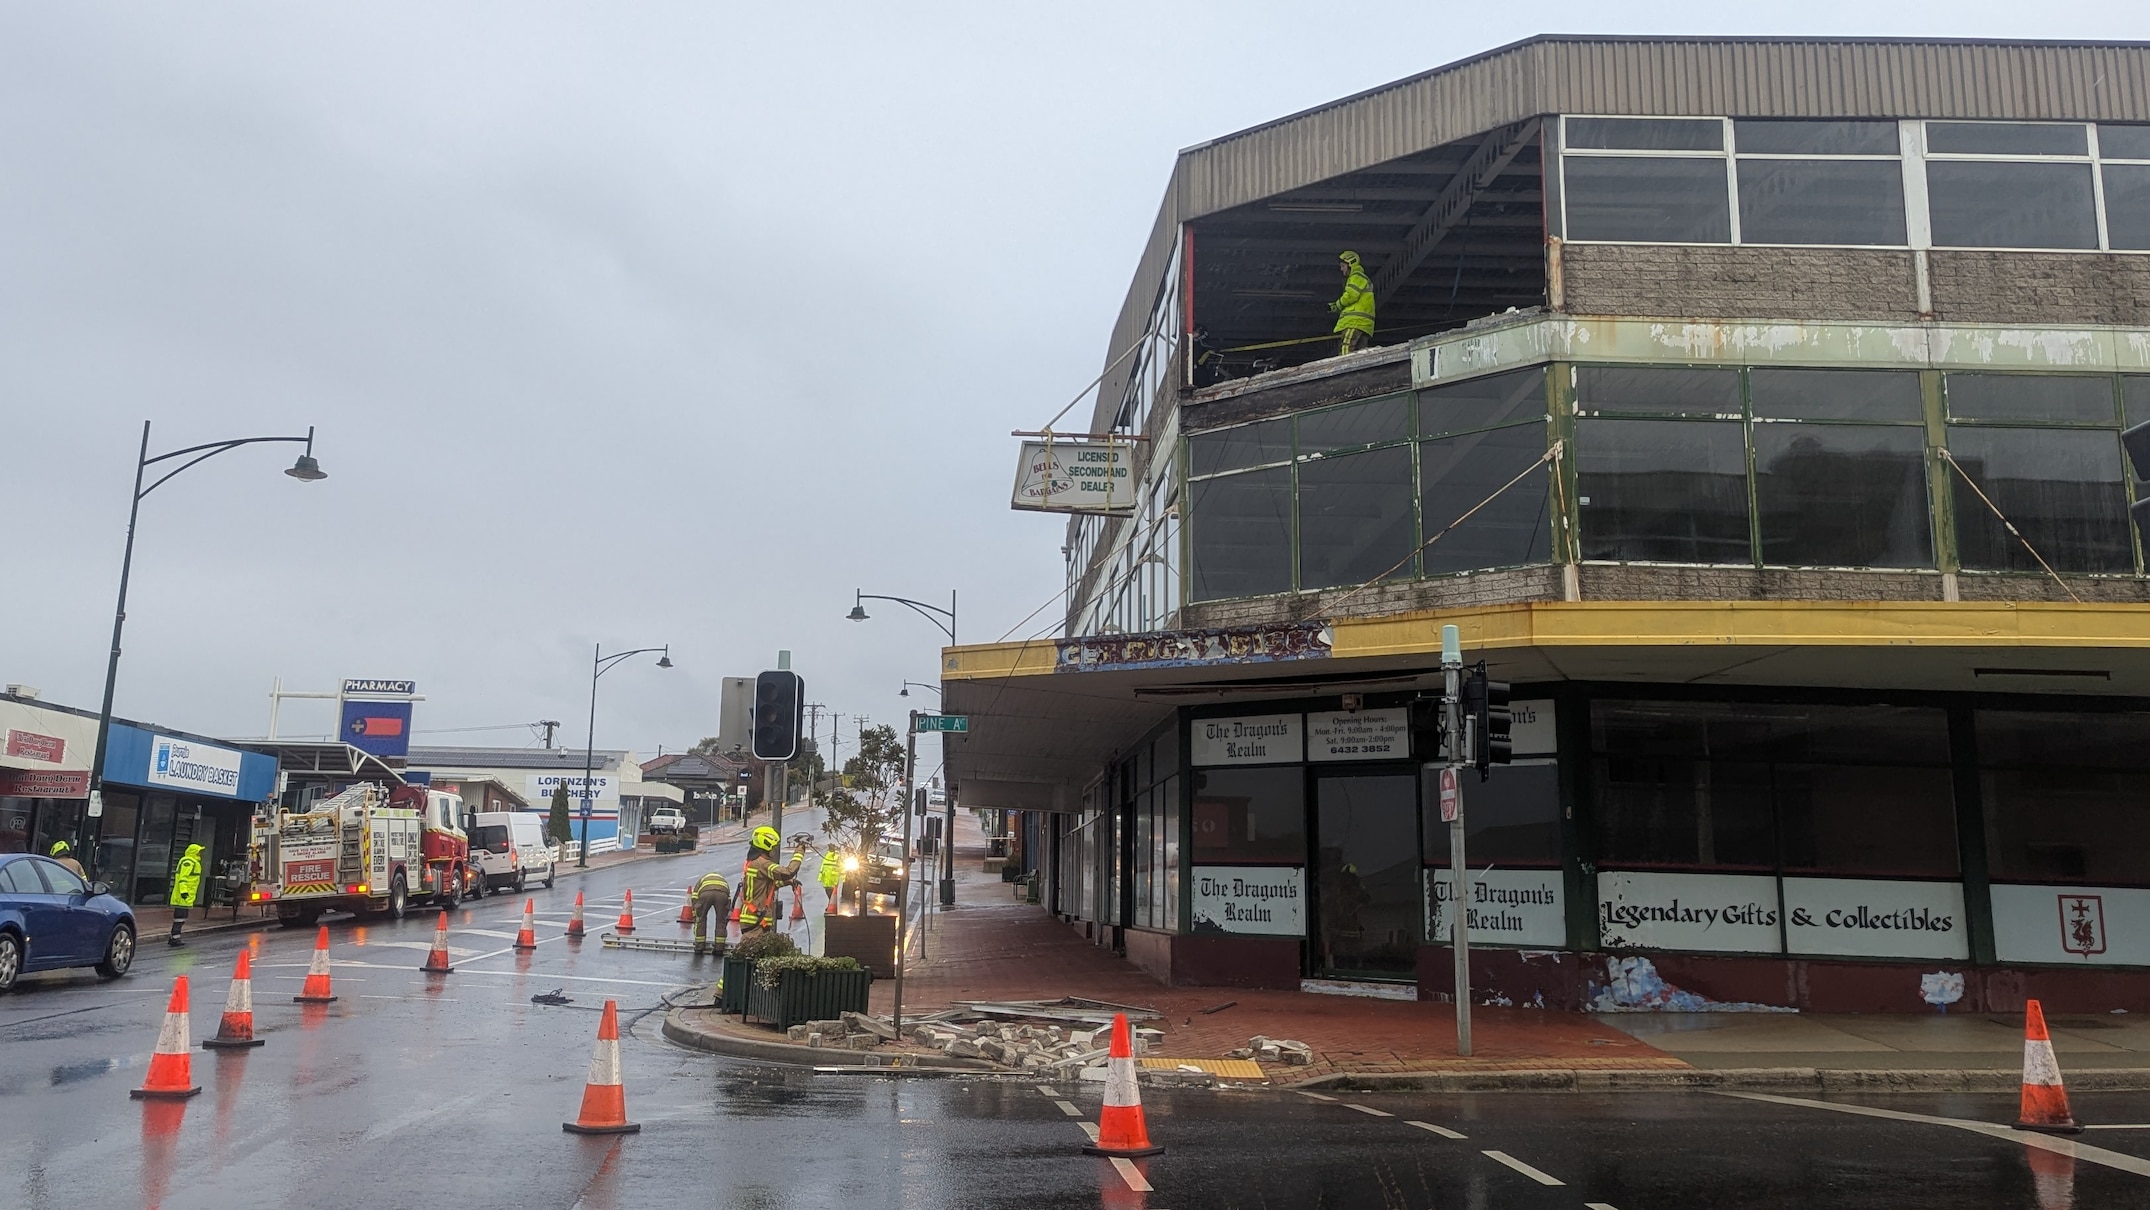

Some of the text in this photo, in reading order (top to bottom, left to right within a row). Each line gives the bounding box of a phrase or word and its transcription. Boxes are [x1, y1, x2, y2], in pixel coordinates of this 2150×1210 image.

[1068, 466, 1128, 478] SECONDHAND
[1080, 481, 1115, 493] DEALER
[345, 680, 411, 692] PHARMACY
[919, 717, 946, 730] PINE
[1332, 716, 1387, 726] Opening Hours:
[1206, 719, 1288, 743] The Dragon's
[1226, 741, 1266, 758] Realm
[1330, 745, 1391, 754] 6432 3852
[168, 759, 239, 787] LAUNDRY BASKET
[299, 864, 321, 873] FIRE
[291, 872, 331, 882] RESCUE
[1200, 878, 1297, 902] The Dragon's
[1474, 881, 1555, 908] Dragon's
[1225, 902, 1272, 922] Realm
[1467, 908, 1524, 931] Realm
[1603, 899, 1954, 932] Legendary Gifts & Collectibles
